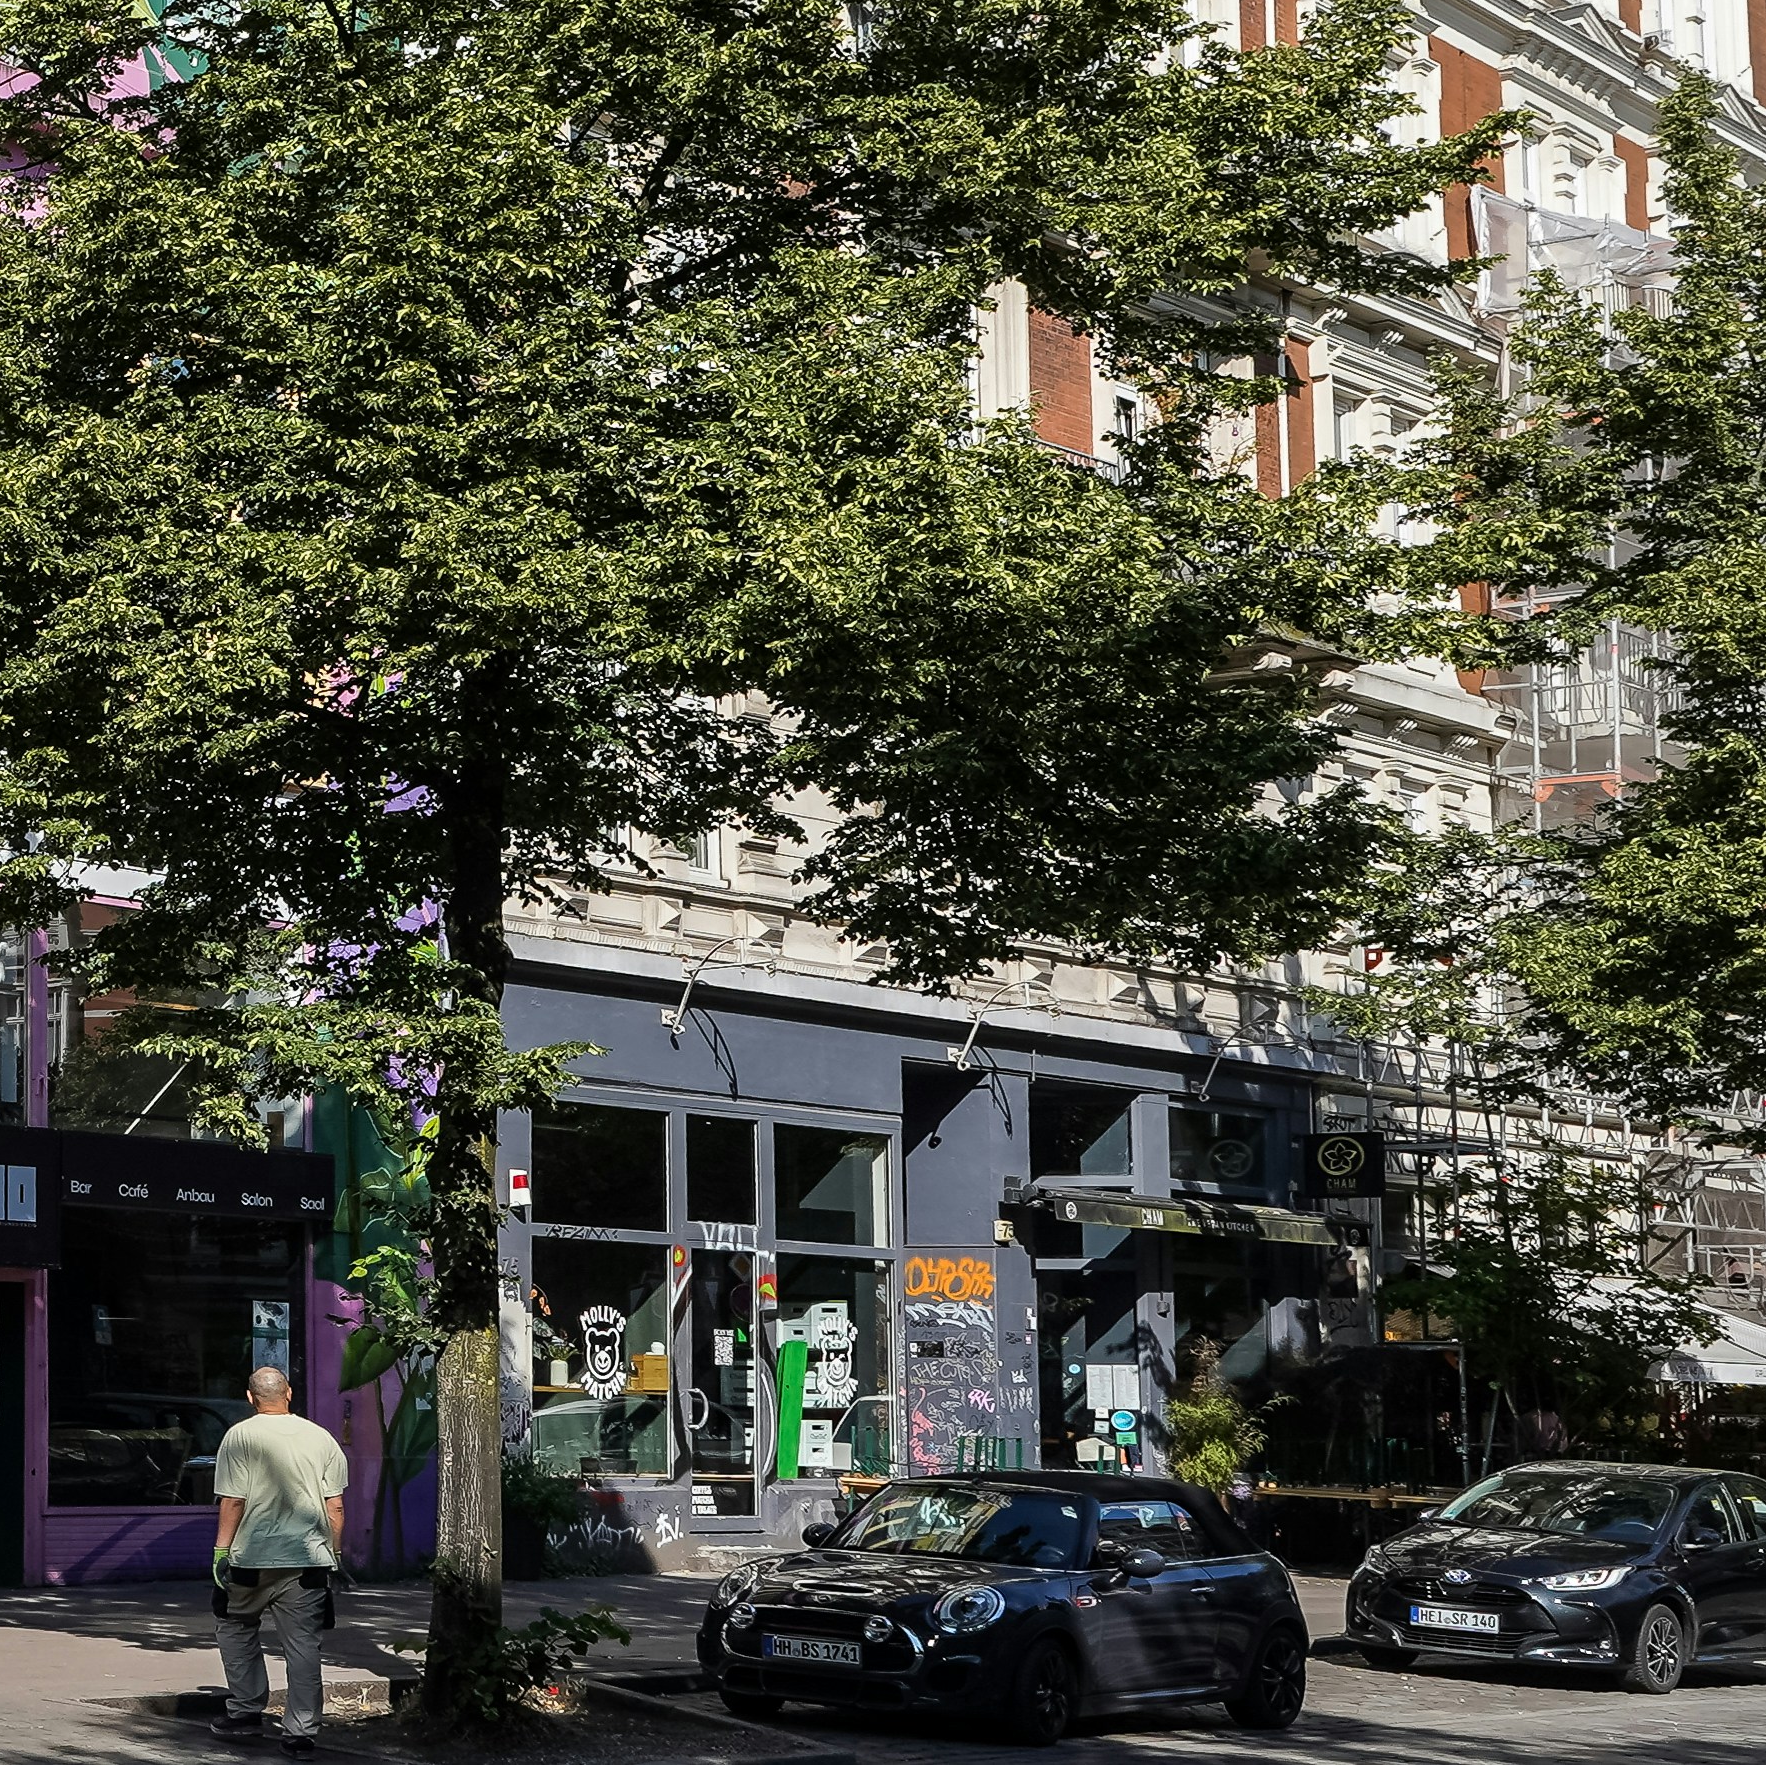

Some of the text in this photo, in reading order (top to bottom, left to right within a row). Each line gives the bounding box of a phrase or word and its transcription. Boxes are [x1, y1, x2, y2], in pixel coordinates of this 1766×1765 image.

[70, 1180, 326, 1212] Bar Café Anbau Salon Saal
[1326, 1178, 1357, 1190] CHAM
[1141, 1208, 1164, 1226] CHAM
[579, 1304, 627, 1334] MOLLY'S
[581, 1370, 628, 1401] MATCHA
[1420, 1609, 1496, 1629] HEI SR 140
[773, 1637, 859, 1663] HH BS 1741
